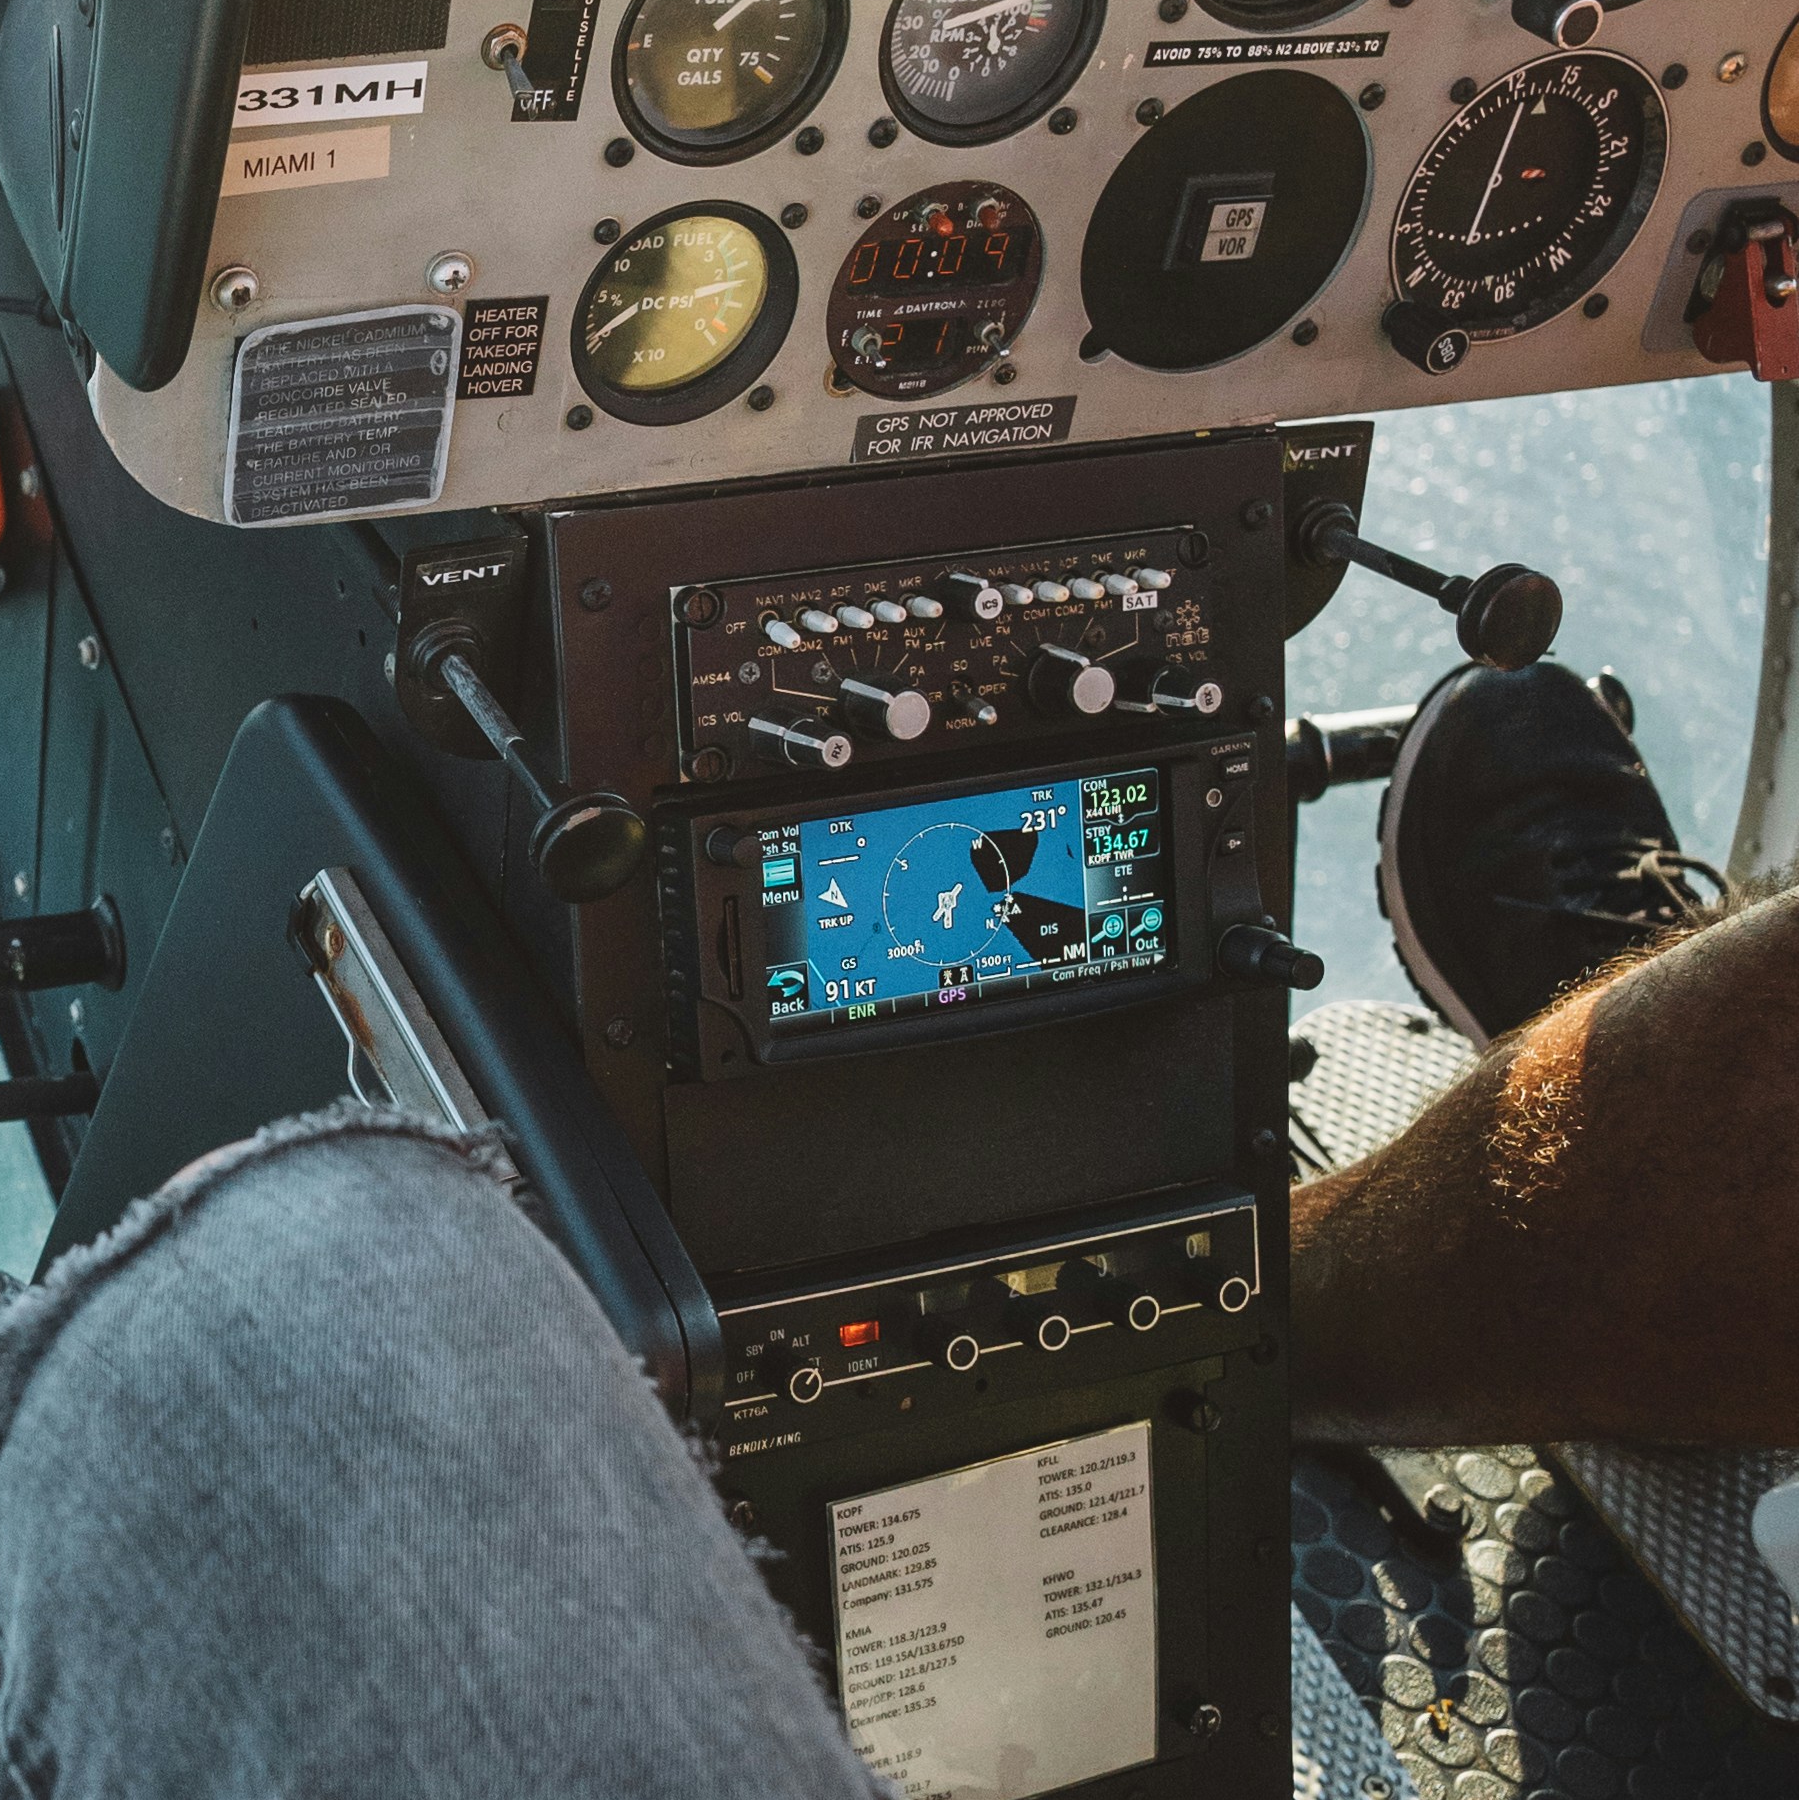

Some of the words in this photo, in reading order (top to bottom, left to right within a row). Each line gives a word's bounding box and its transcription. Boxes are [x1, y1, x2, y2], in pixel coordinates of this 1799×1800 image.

[687, 48, 724, 63] QTY
[1153, 48, 1191, 61] AVOID
[1198, 47, 1222, 59] 75%
[1226, 46, 1241, 57] TO
[1248, 45, 1272, 57] 88%
[1276, 44, 1291, 55] N2
[1294, 41, 1333, 55] ABOVE
[1336, 41, 1360, 53] 33%
[1364, 40, 1379, 51] TQ
[739, 52, 759, 66] 75
[678, 70, 722, 85] GALS
[238, 78, 422, 112] 331MH
[244, 152, 315, 179] MIAMI
[326, 149, 336, 169] 1
[1226, 208, 1253, 227] GPS
[1218, 237, 1246, 255] VOR
[642, 297, 664, 310] DC
[669, 296, 693, 309] PSI
[906, 302, 957, 314] DAVTRON
[475, 307, 538, 323] HEATER
[857, 309, 882, 319] TIME
[469, 329, 502, 341] OFF
[506, 325, 538, 339] FOR
[466, 343, 537, 359] TAKEOFF
[1438, 337, 1455, 363] OBS
[463, 361, 533, 377] LANDING
[348, 377, 392, 395] VALVE
[467, 379, 522, 395] HOVER
[876, 417, 909, 434] GPS
[919, 411, 958, 429] NOT
[965, 403, 1053, 426] APPROVED
[867, 439, 900, 456] FOR
[911, 435, 933, 451] IFR
[943, 424, 1052, 449] NAVIGATION
[1289, 444, 1357, 461] VENT
[328, 455, 421, 476] MONITORING
[422, 564, 506, 586] VENT
[899, 576, 922, 588] MKR
[791, 590, 822, 602] NAV2
[1126, 594, 1153, 608] SAT
[981, 599, 999, 610] ICS
[692, 672, 732, 685] AMS44
[698, 715, 717, 726] ICS
[723, 712, 745, 723] VOL
[1032, 790, 1053, 802] TRK
[1090, 784, 1147, 808] 123.02
[829, 821, 853, 834] DTK
[1093, 828, 1149, 854] 134.67
[1114, 865, 1133, 877] ETE
[762, 890, 799, 905] Menu
[818, 918, 838, 929] TRK
[840, 915, 854, 925] UP
[1063, 943, 1085, 960] NM
[1103, 944, 1115, 956] In
[1135, 936, 1159, 951] Out
[1078, 963, 1100, 978] Freq
[1111, 959, 1128, 971] Psh
[1131, 955, 1151, 967] Nav
[825, 980, 850, 1001] 91
[855, 979, 876, 997] KT
[939, 987, 966, 1003] GPS
[772, 998, 805, 1015] Back
[848, 1004, 876, 1019] ENR
[770, 1329, 785, 1341] ON
[792, 1334, 810, 1348] ALT
[746, 1344, 764, 1357] SBY
[848, 1357, 879, 1373] IDENT
[729, 1432, 801, 1456] BENDIX/KING
[1039, 1468, 1077, 1486] TOWER:
[1080, 1452, 1136, 1475] 120.2/119.3
[1039, 1488, 1062, 1504] ATIS:
[1066, 1482, 1092, 1496] 135.0
[837, 1505, 863, 1520] KOPF
[838, 1521, 879, 1538] TOWER:
[882, 1509, 921, 1528] 134.675
[1040, 1515, 1099, 1538] CLEARANCE:
[1102, 1507, 1127, 1522] 128.4
[841, 1554, 889, 1574] GROUND:
[892, 1542, 930, 1561] 120.025
[842, 1569, 902, 1592] LANDMARK:
[847, 1640, 886, 1658] TOWER:
